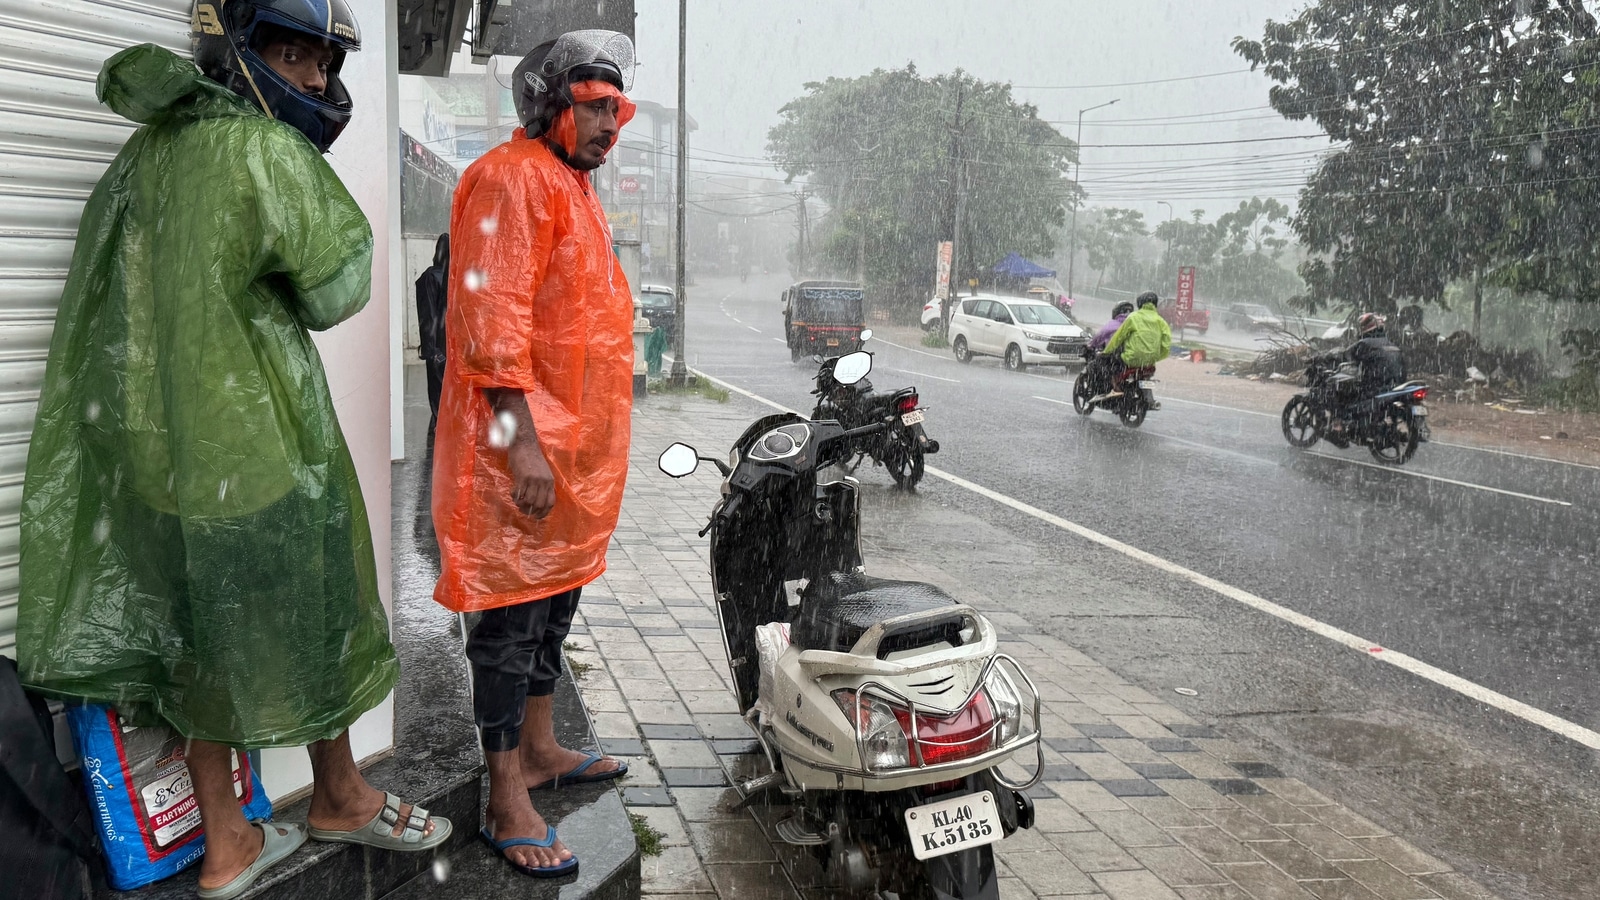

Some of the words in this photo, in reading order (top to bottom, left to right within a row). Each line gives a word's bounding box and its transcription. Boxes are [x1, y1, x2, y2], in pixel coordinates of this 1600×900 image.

[85, 756, 118, 841] EXCELERTHINGS
[155, 797, 196, 826] EARTHING
[931, 804, 973, 828] KL.40
[921, 819, 992, 851] K.5135
